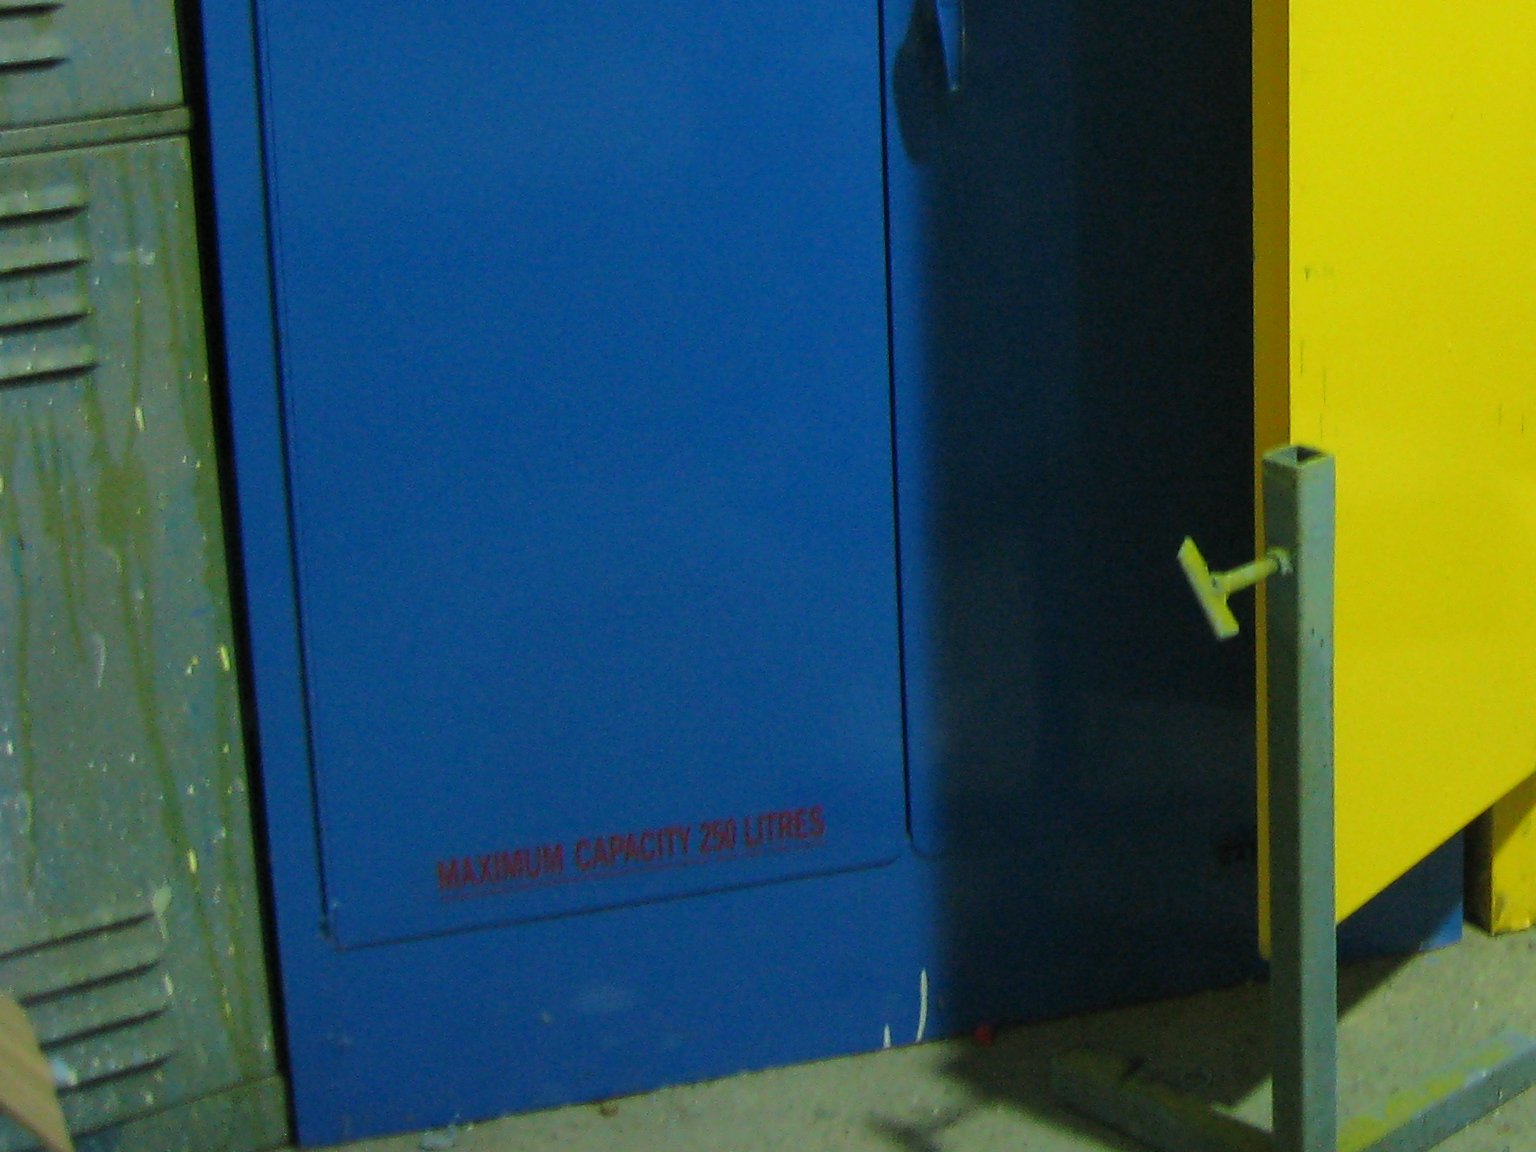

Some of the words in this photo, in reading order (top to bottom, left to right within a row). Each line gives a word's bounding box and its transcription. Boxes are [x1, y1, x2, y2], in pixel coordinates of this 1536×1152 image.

[436, 842, 565, 890] MAXIMUM
[574, 825, 692, 871] CAPACITY
[698, 816, 738, 856] 250
[743, 803, 827, 847] LITRES
